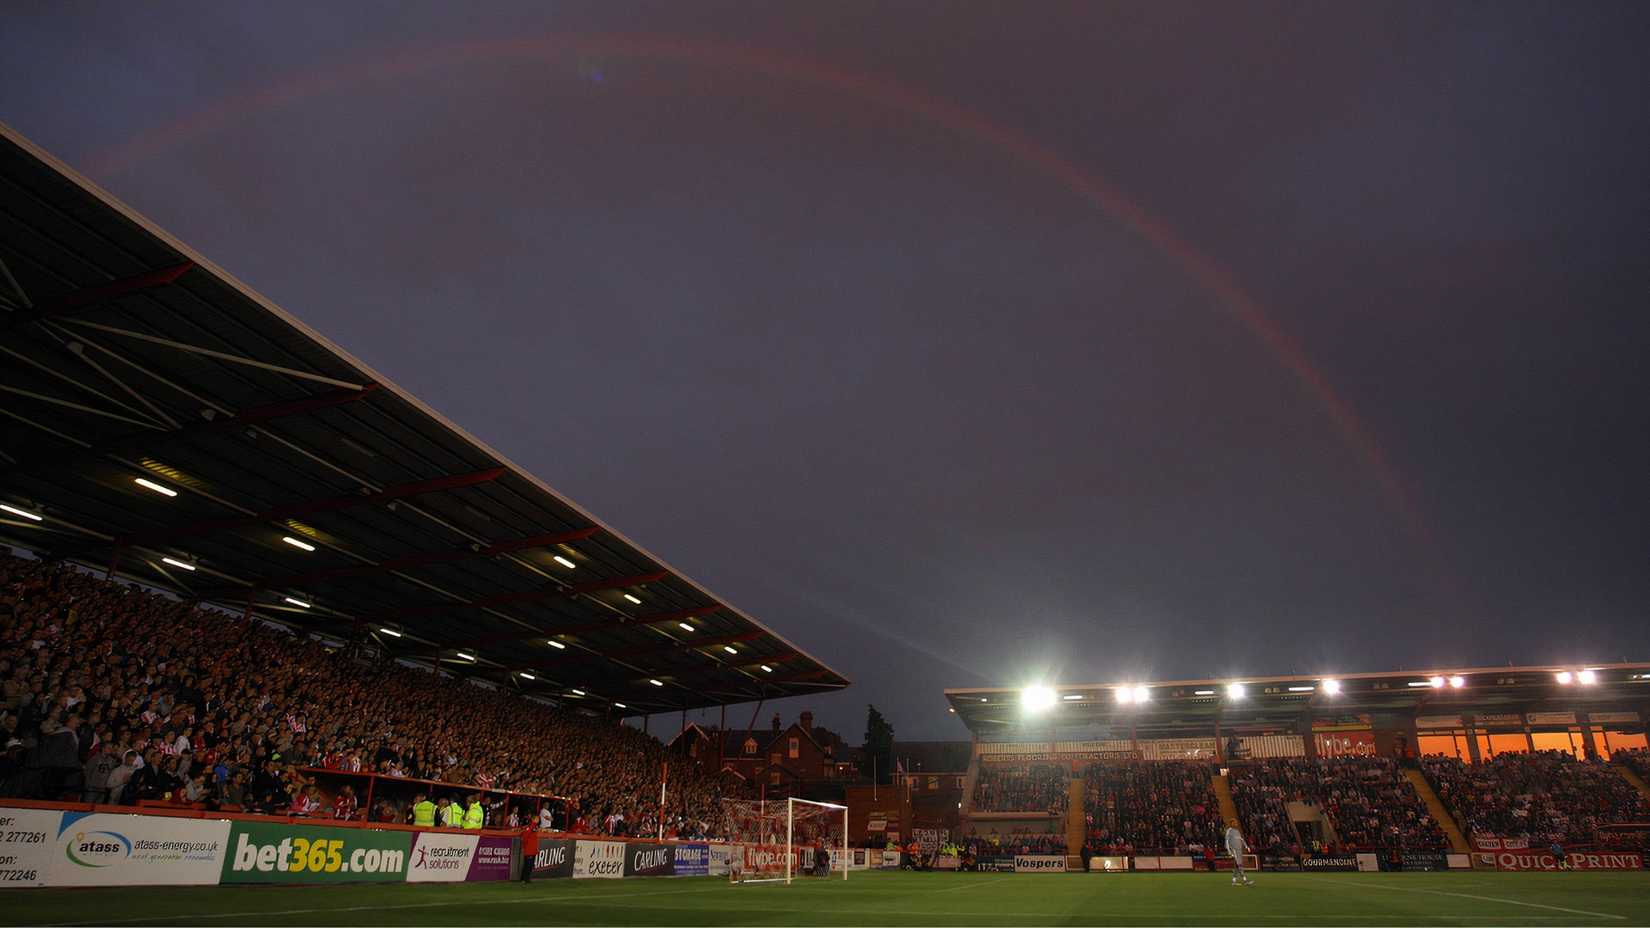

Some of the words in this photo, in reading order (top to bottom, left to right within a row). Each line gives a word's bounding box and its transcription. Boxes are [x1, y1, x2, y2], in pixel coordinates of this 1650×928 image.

[1314, 733, 1377, 758] flybe.com
[6, 831, 47, 843] 277261
[79, 841, 120, 853] atass
[134, 840, 218, 853] atass-energy.co.uk
[232, 833, 405, 873] bet365.com
[430, 847, 470, 858] recruitment
[633, 848, 668, 872] CARLING
[748, 846, 798, 866] flybe.com
[1016, 857, 1064, 869] Vospers
[1499, 852, 1568, 871] QUIC
[1571, 853, 1640, 869] PRINT
[429, 860, 460, 870] solutions
[589, 860, 622, 876] exeter
